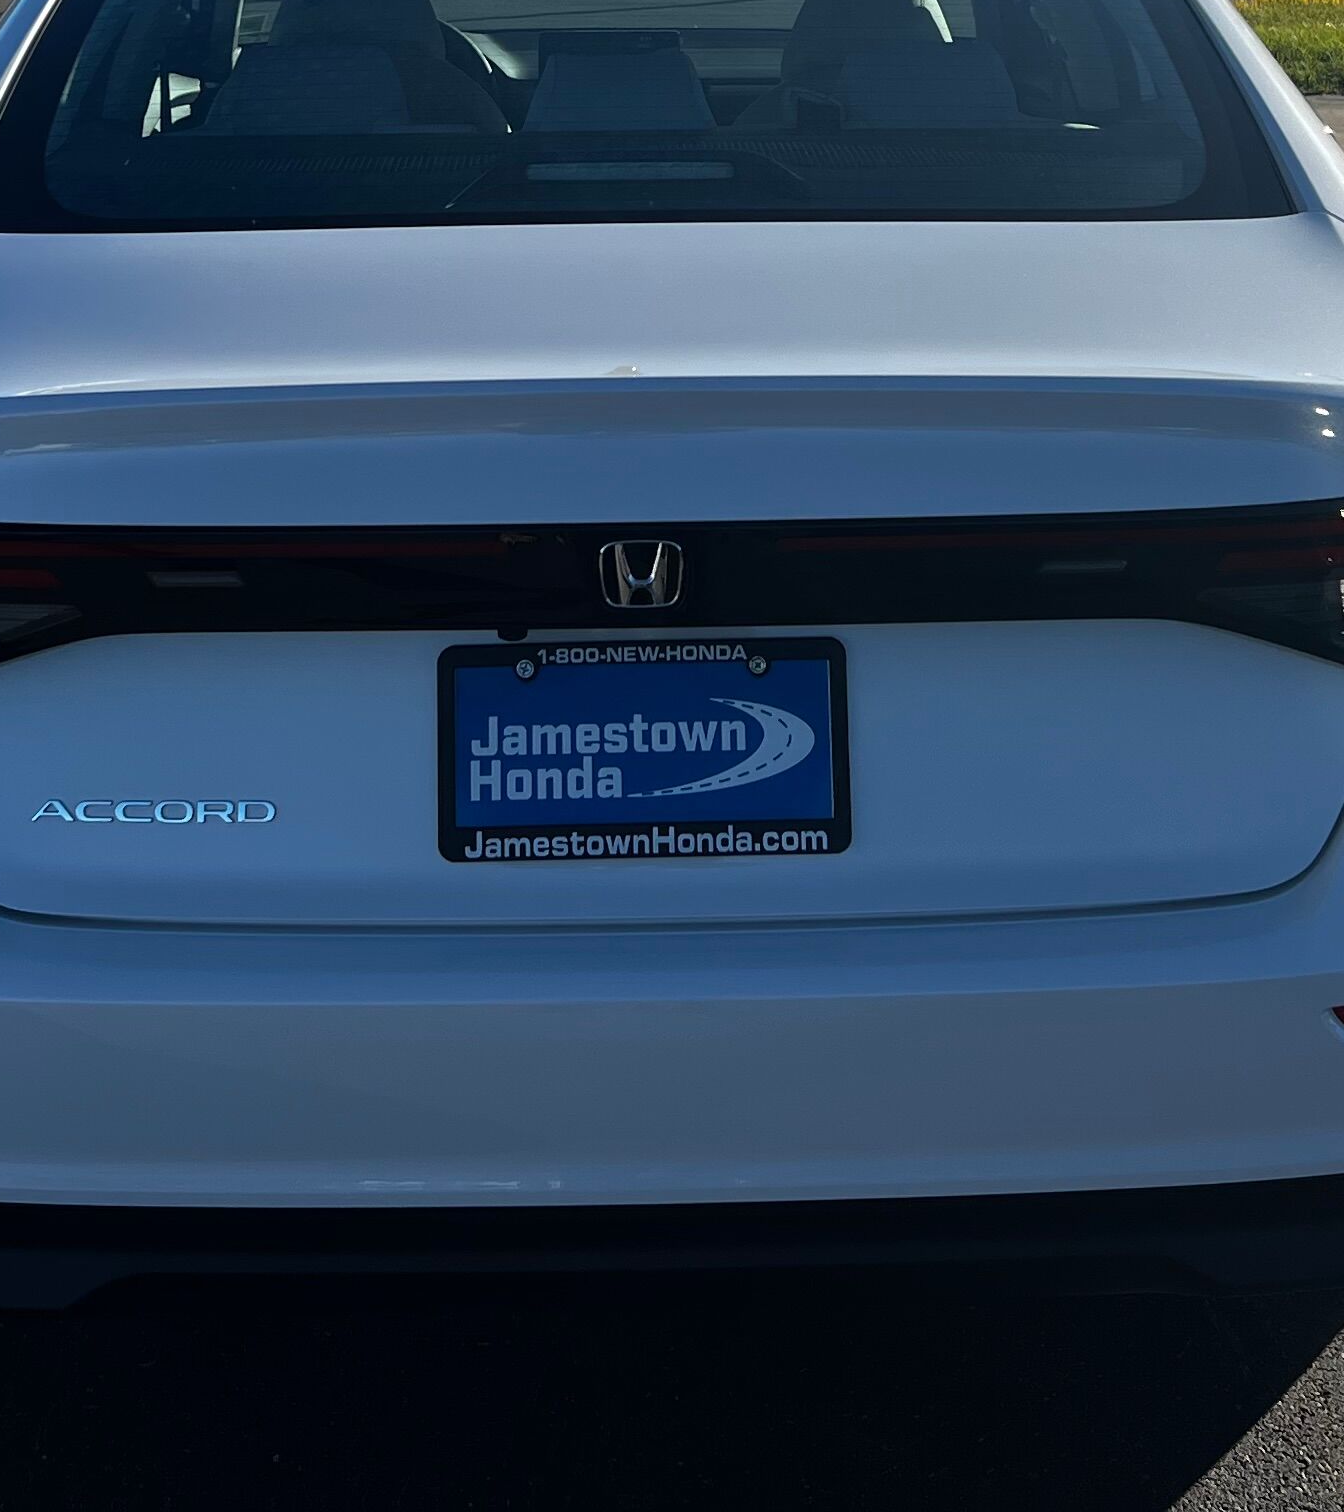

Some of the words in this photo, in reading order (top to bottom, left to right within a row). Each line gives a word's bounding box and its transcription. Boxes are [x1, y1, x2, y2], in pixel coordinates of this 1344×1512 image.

[537, 644, 748, 664] 1-800-NEW-HONDA
[470, 714, 747, 757] Jamestown
[469, 756, 624, 802] Honda
[31, 800, 277, 823] ACCORD
[464, 825, 829, 859] JamestownHonda.com
